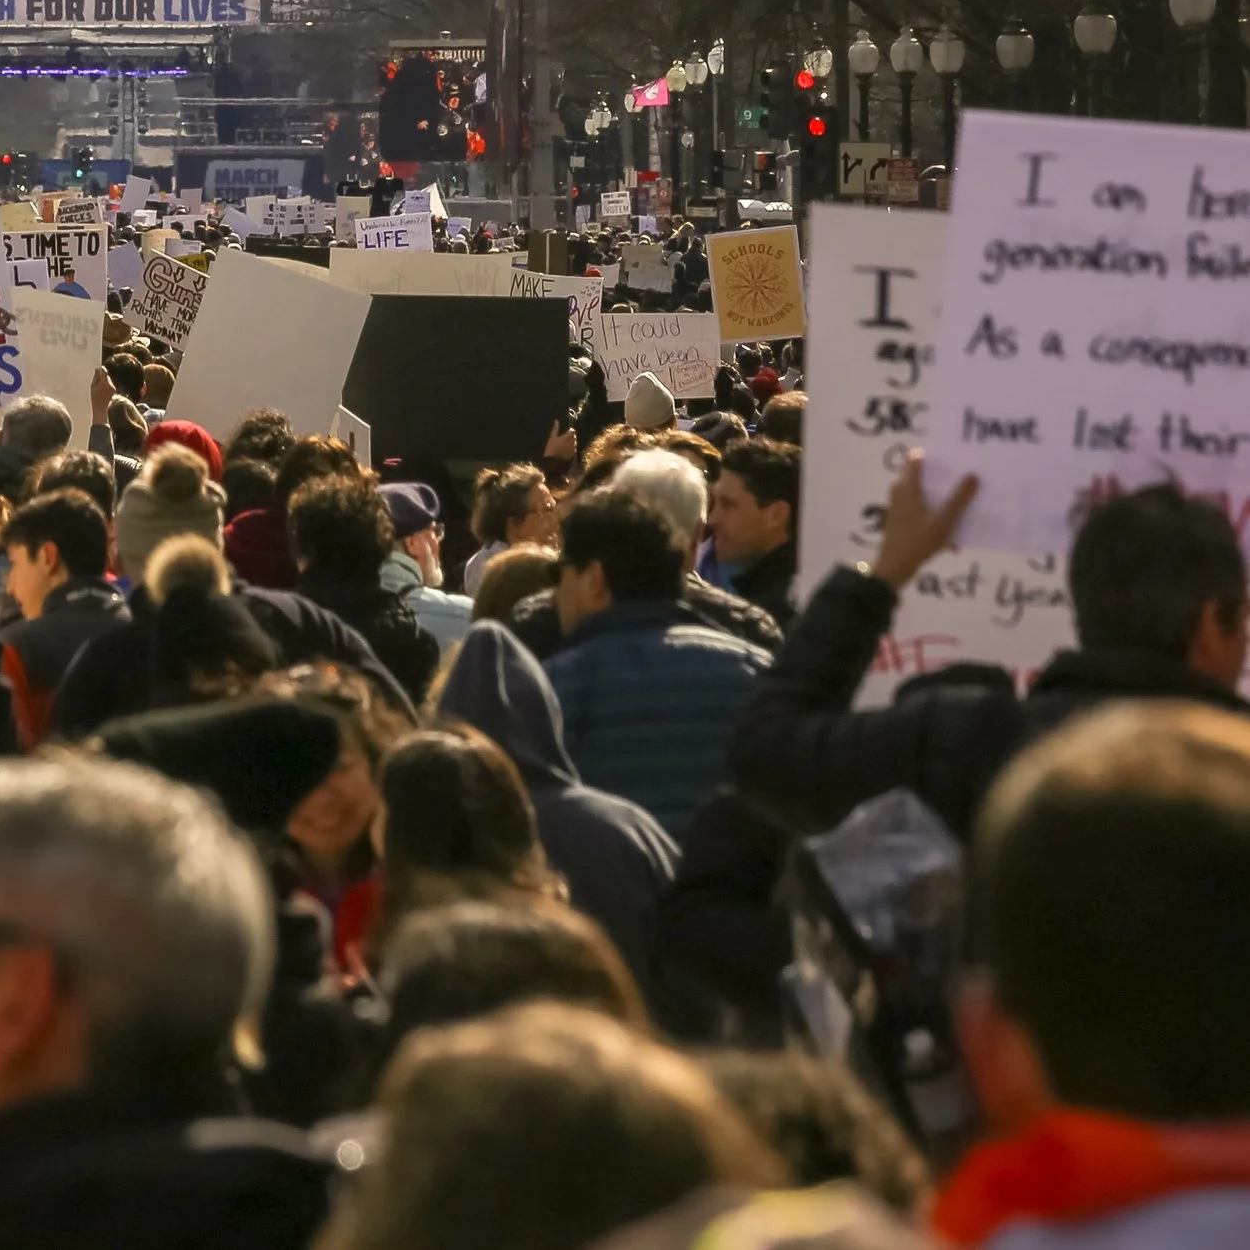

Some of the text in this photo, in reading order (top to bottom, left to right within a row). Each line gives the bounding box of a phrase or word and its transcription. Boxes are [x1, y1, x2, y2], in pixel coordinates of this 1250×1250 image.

[1015, 152, 1057, 207] I
[21, 232, 70, 258] TIME
[74, 231, 100, 257] TO
[722, 243, 784, 266] SCHOOLS
[510, 273, 555, 297] MAKE
[601, 315, 682, 350] It could
[726, 309, 746, 324] NOT
[964, 313, 1019, 360] As
[1041, 330, 1066, 360] a
[600, 353, 651, 380] have
[655, 345, 701, 367] been
[962, 405, 1040, 444] have
